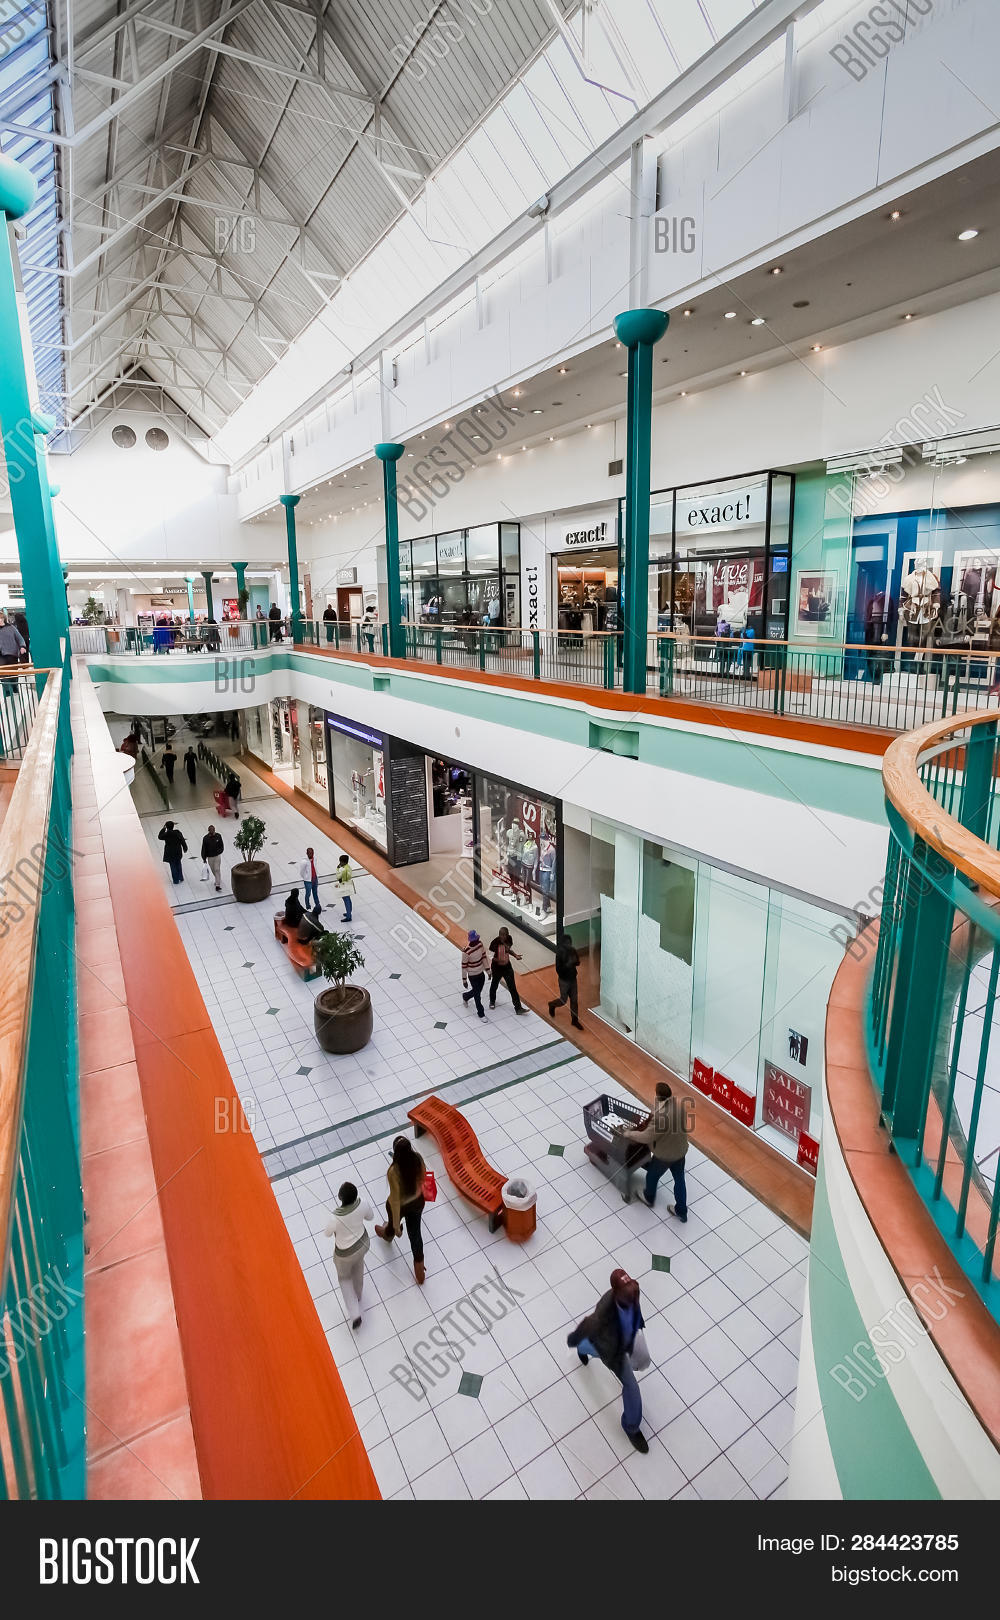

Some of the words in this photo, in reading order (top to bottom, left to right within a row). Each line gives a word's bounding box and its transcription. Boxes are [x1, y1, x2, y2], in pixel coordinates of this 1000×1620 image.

[688, 494, 751, 526] exact!
[565, 522, 607, 545] exact!
[769, 1068, 805, 1099] SALE
[732, 1097, 749, 1115] SALE
[768, 1088, 803, 1120] SALE
